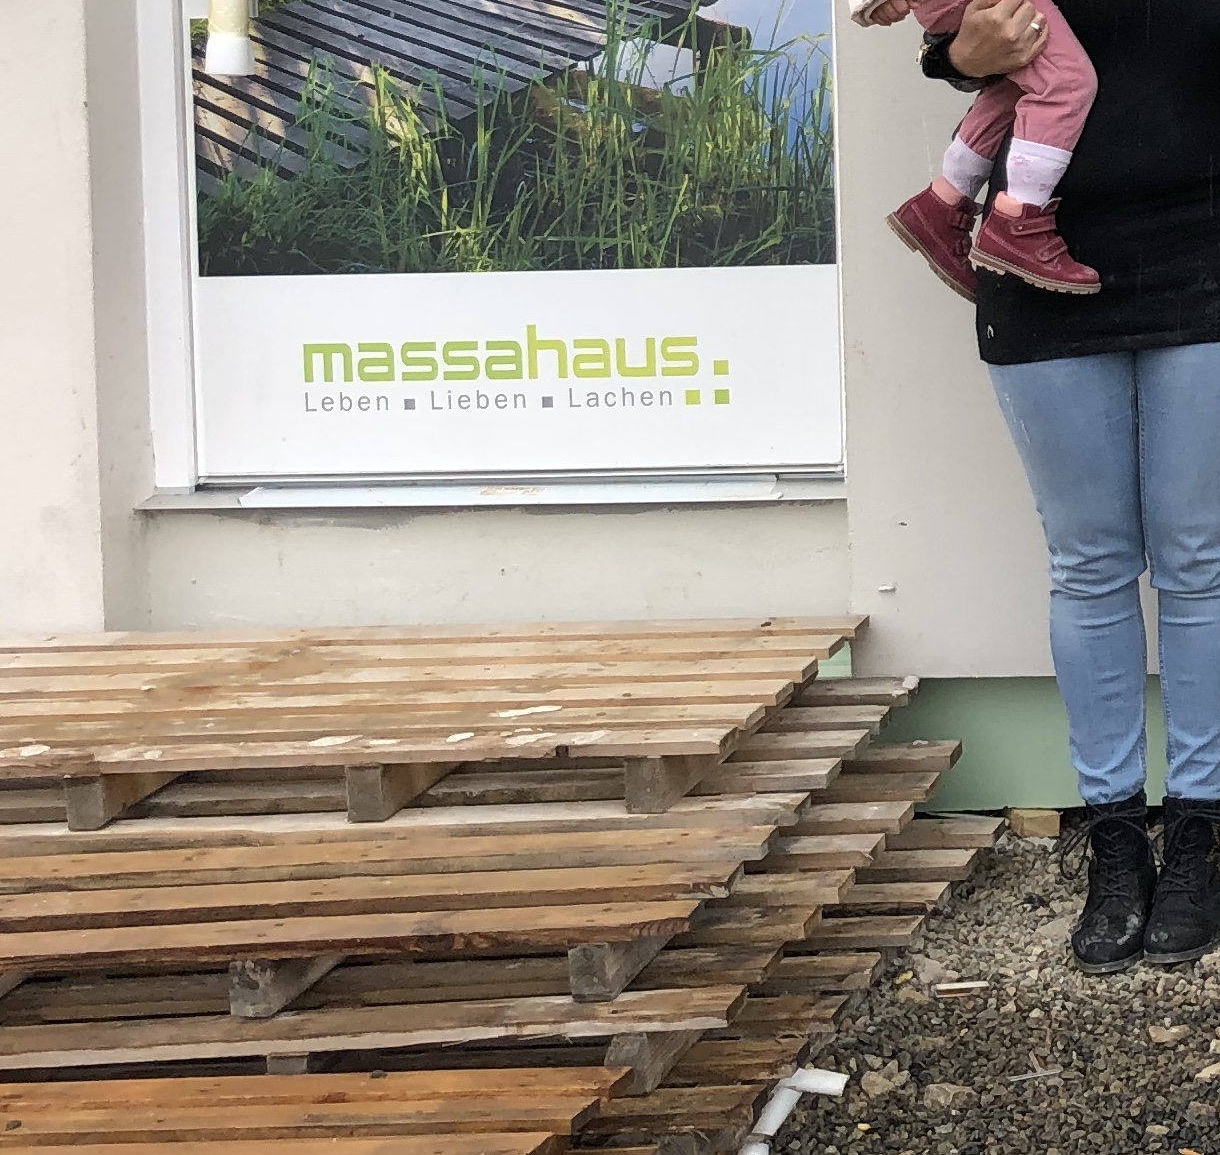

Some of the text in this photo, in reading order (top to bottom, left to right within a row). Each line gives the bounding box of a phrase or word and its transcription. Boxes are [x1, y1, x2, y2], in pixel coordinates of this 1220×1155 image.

[304, 386, 673, 412] Leben Lieben Lachen
